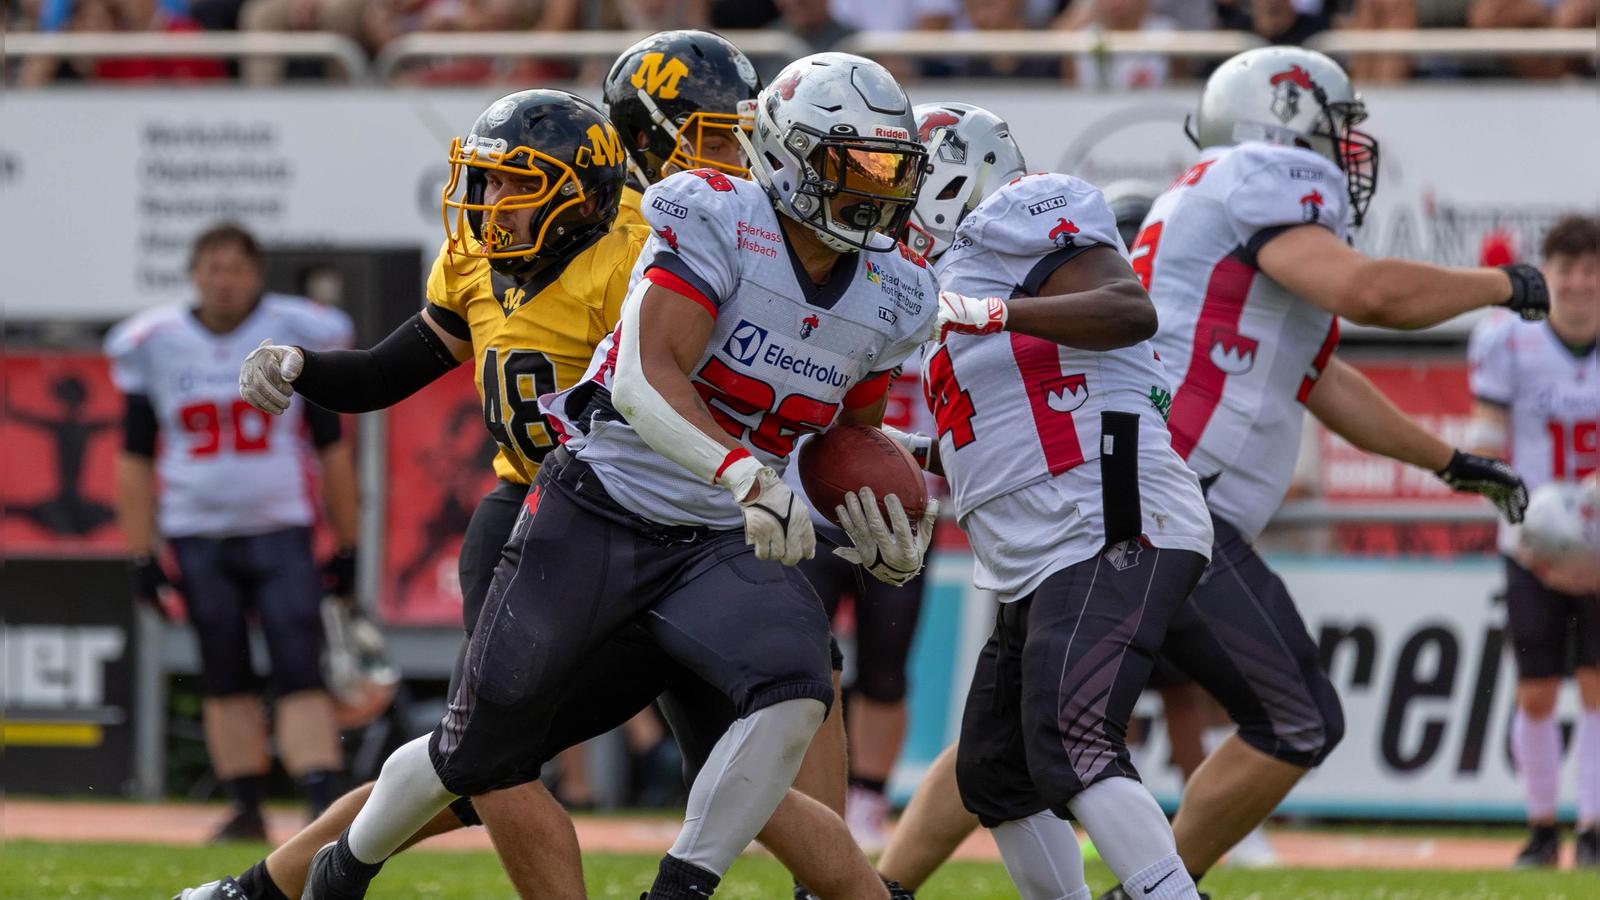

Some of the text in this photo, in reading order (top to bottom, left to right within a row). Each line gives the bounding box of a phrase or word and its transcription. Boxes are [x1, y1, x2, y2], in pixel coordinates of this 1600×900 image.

[630, 52, 689, 99] M
[586, 123, 625, 167] M
[875, 127, 908, 139] Riddell
[653, 198, 687, 218] TNKD
[1029, 196, 1066, 215] TNKD
[503, 288, 526, 310] M
[881, 270, 925, 301] Stadwerke
[763, 343, 852, 389] Electrolux
[483, 347, 557, 465] 48
[691, 354, 841, 459] 26
[180, 399, 271, 458] 90
